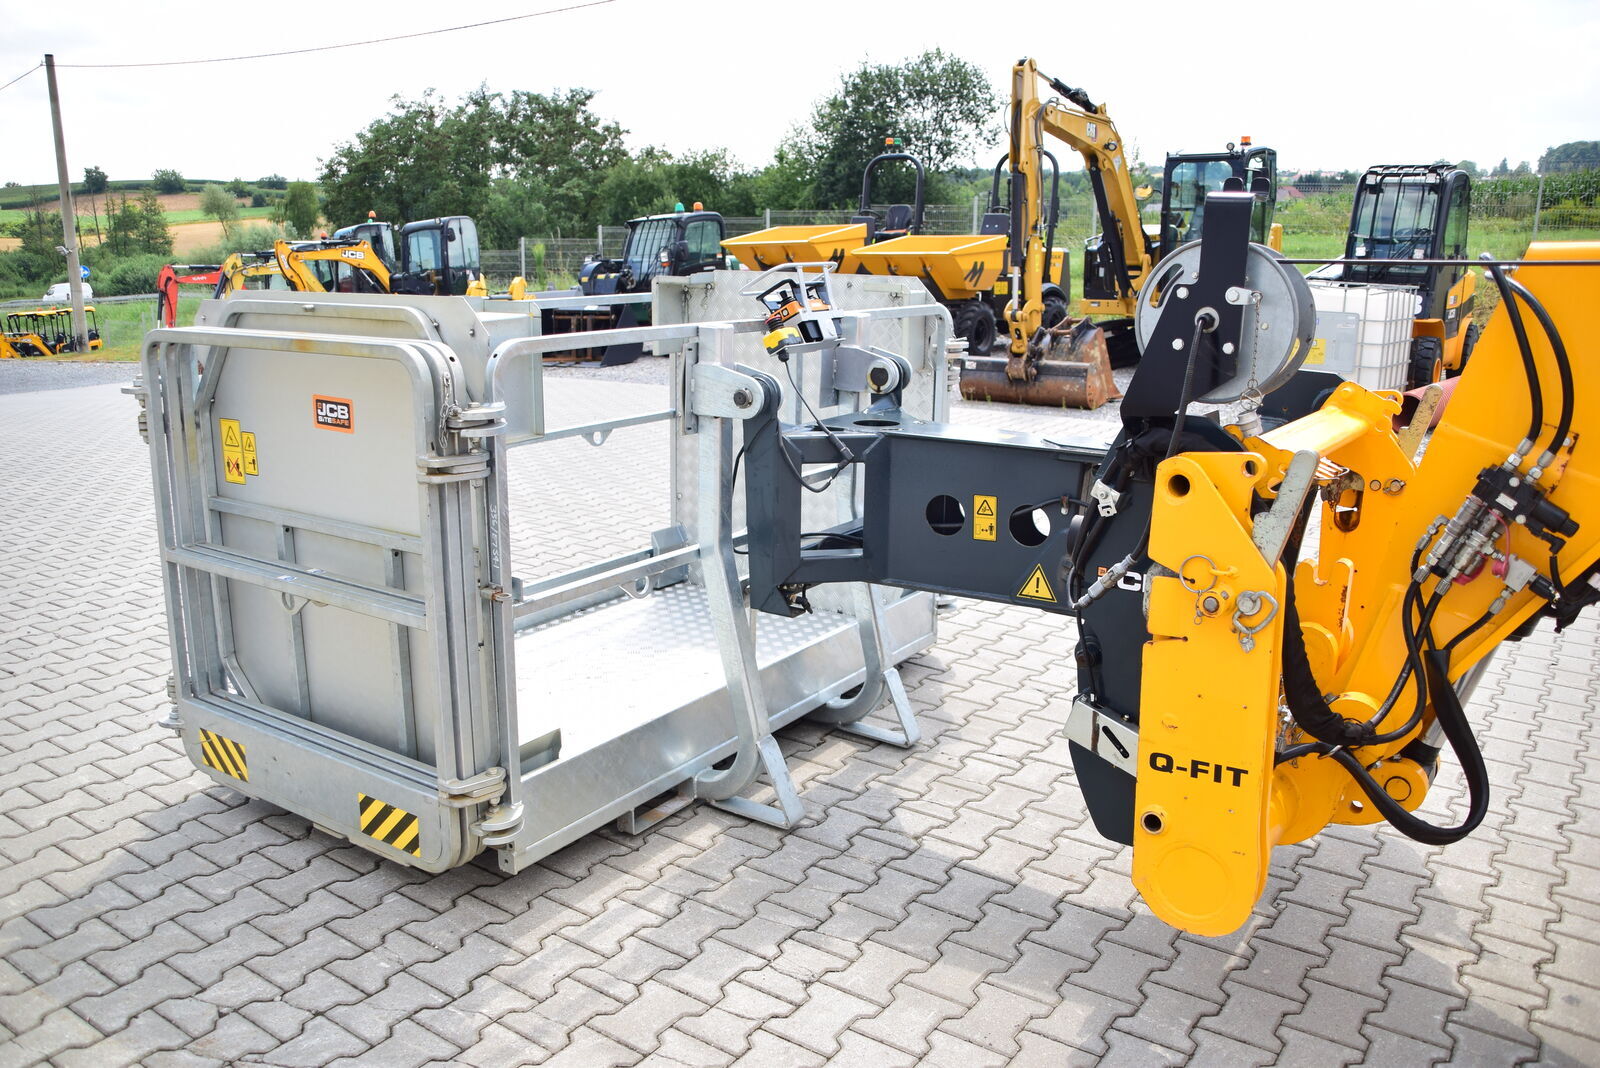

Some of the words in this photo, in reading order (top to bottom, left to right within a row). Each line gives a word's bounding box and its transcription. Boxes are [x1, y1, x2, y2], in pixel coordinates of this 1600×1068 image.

[341, 249, 365, 259] JCB
[317, 402, 350, 420] JCB
[1149, 752, 1249, 787] Q-FIT
